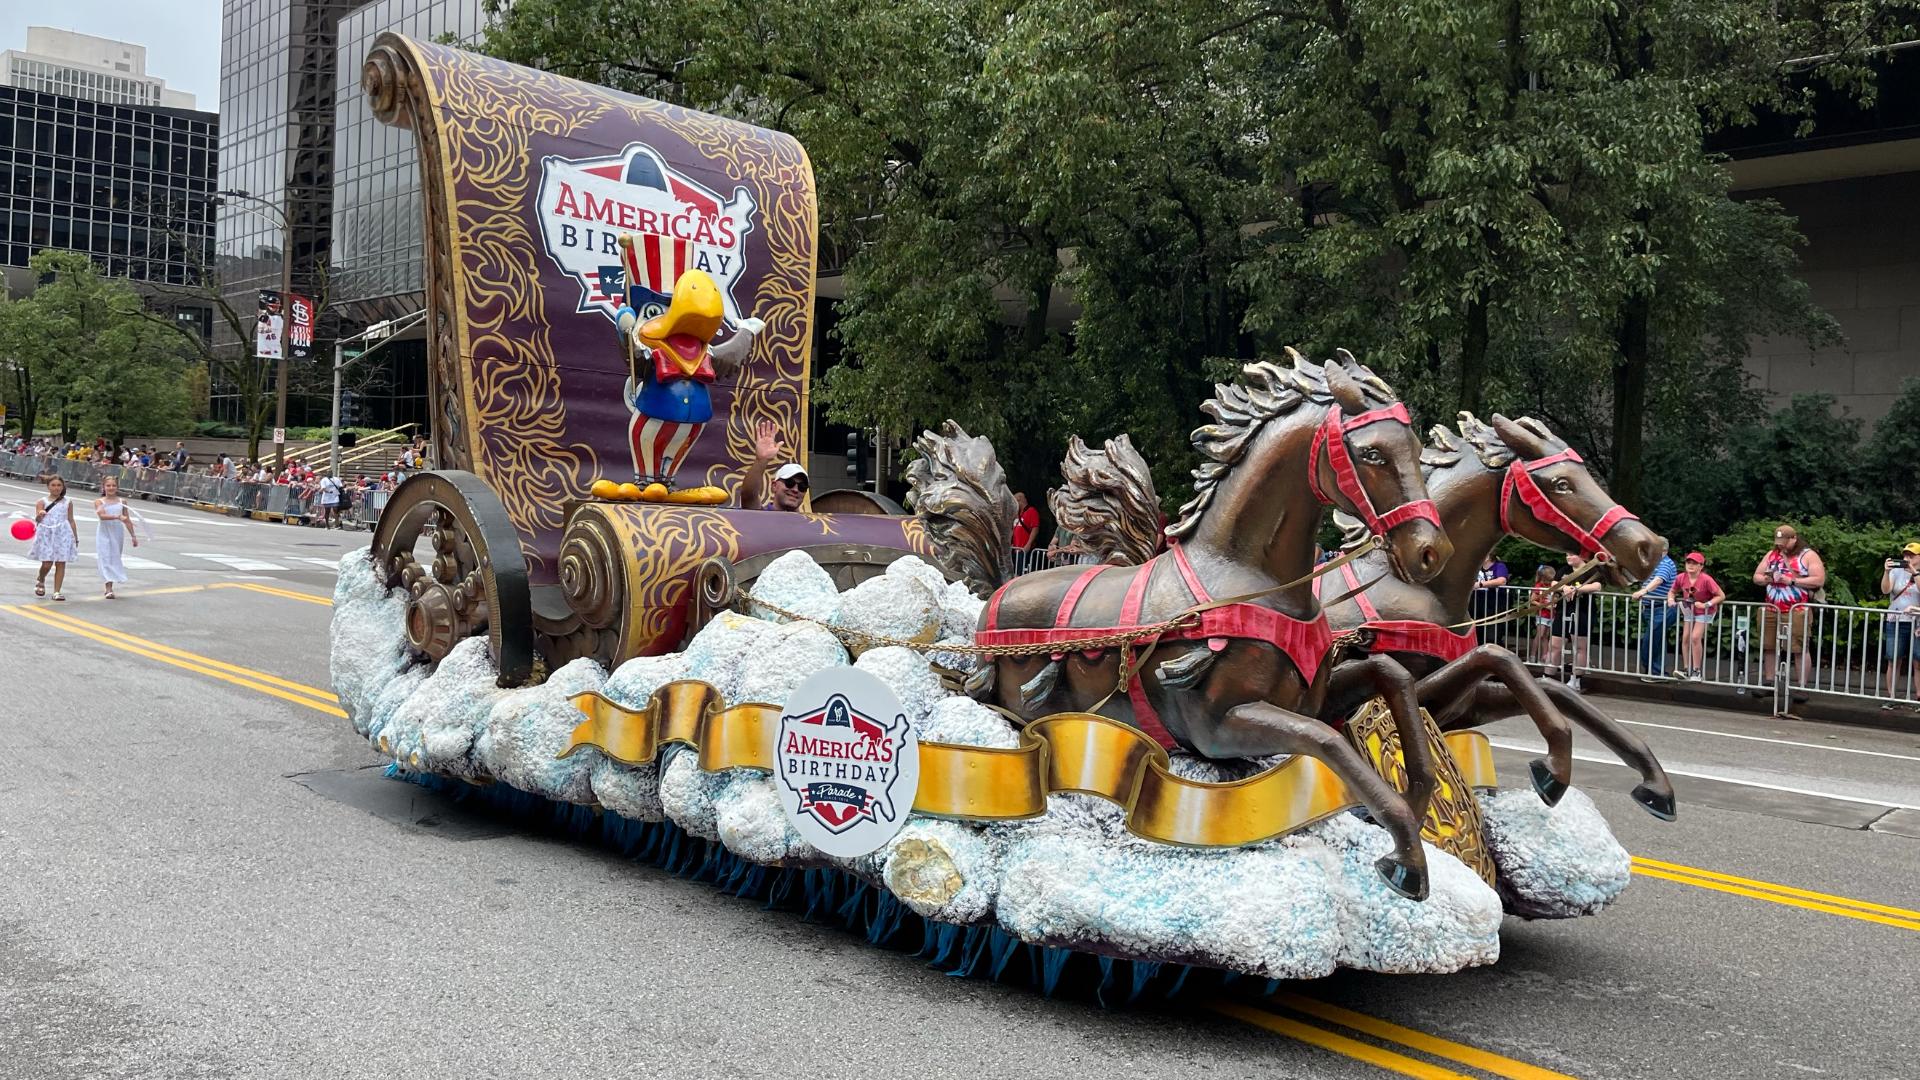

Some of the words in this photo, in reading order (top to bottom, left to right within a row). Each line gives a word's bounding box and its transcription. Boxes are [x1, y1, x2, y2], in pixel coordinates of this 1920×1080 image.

[554, 181, 736, 249] AMERICA'S
[560, 223, 732, 276] BIRAY
[786, 731, 893, 763] AMERICA'S
[788, 758, 890, 783] BIRTHDAY
[816, 783, 857, 799] Parade
